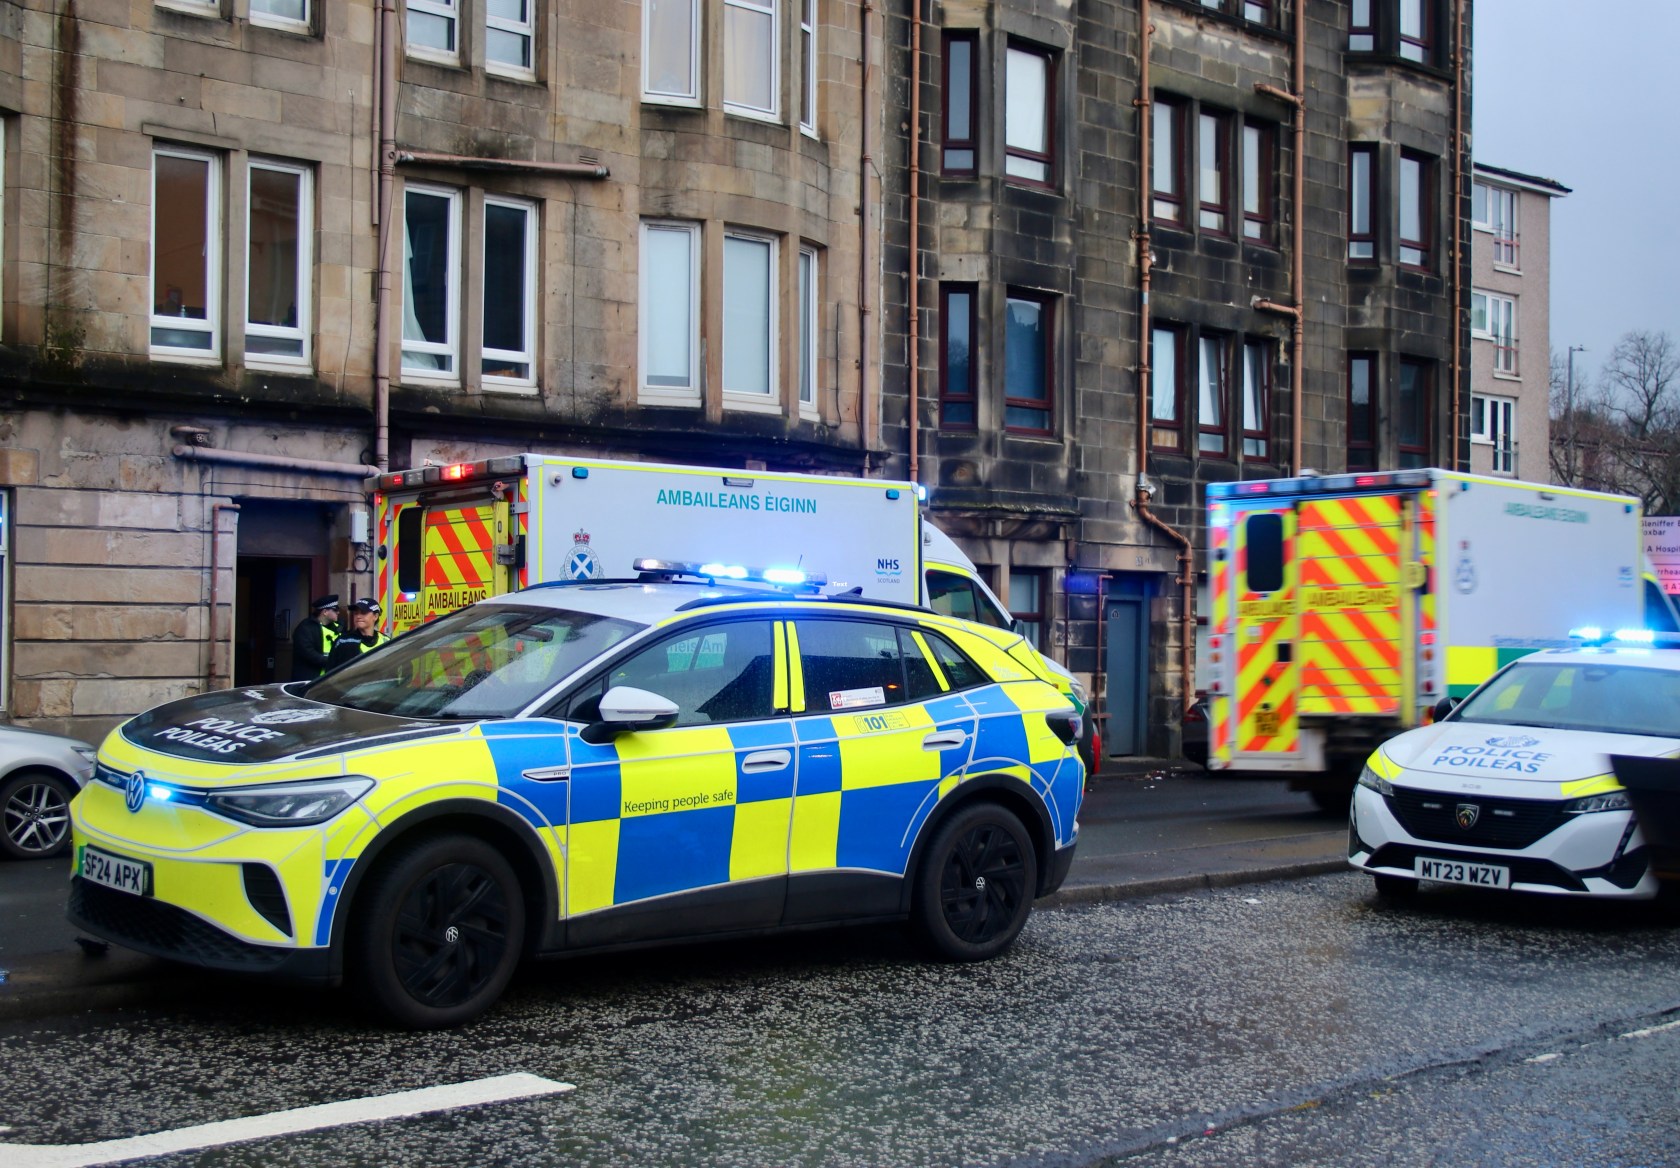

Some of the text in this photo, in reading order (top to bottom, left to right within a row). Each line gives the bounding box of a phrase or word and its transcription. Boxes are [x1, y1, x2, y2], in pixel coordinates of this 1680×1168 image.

[656, 489, 817, 514] AMBAILEANS ÈIGINN
[877, 558, 899, 570] NHS
[428, 589, 487, 609] AMBAILEANS
[184, 717, 286, 743] POLICE
[863, 715, 888, 731] 101
[153, 727, 247, 754] POILEAS
[1432, 755, 1541, 773] POILEAS
[1442, 745, 1552, 762] POLICE
[624, 789, 734, 813] Keeping people safe
[85, 852, 141, 891] SF24 APX
[1421, 860, 1501, 885] MT23 WZV
